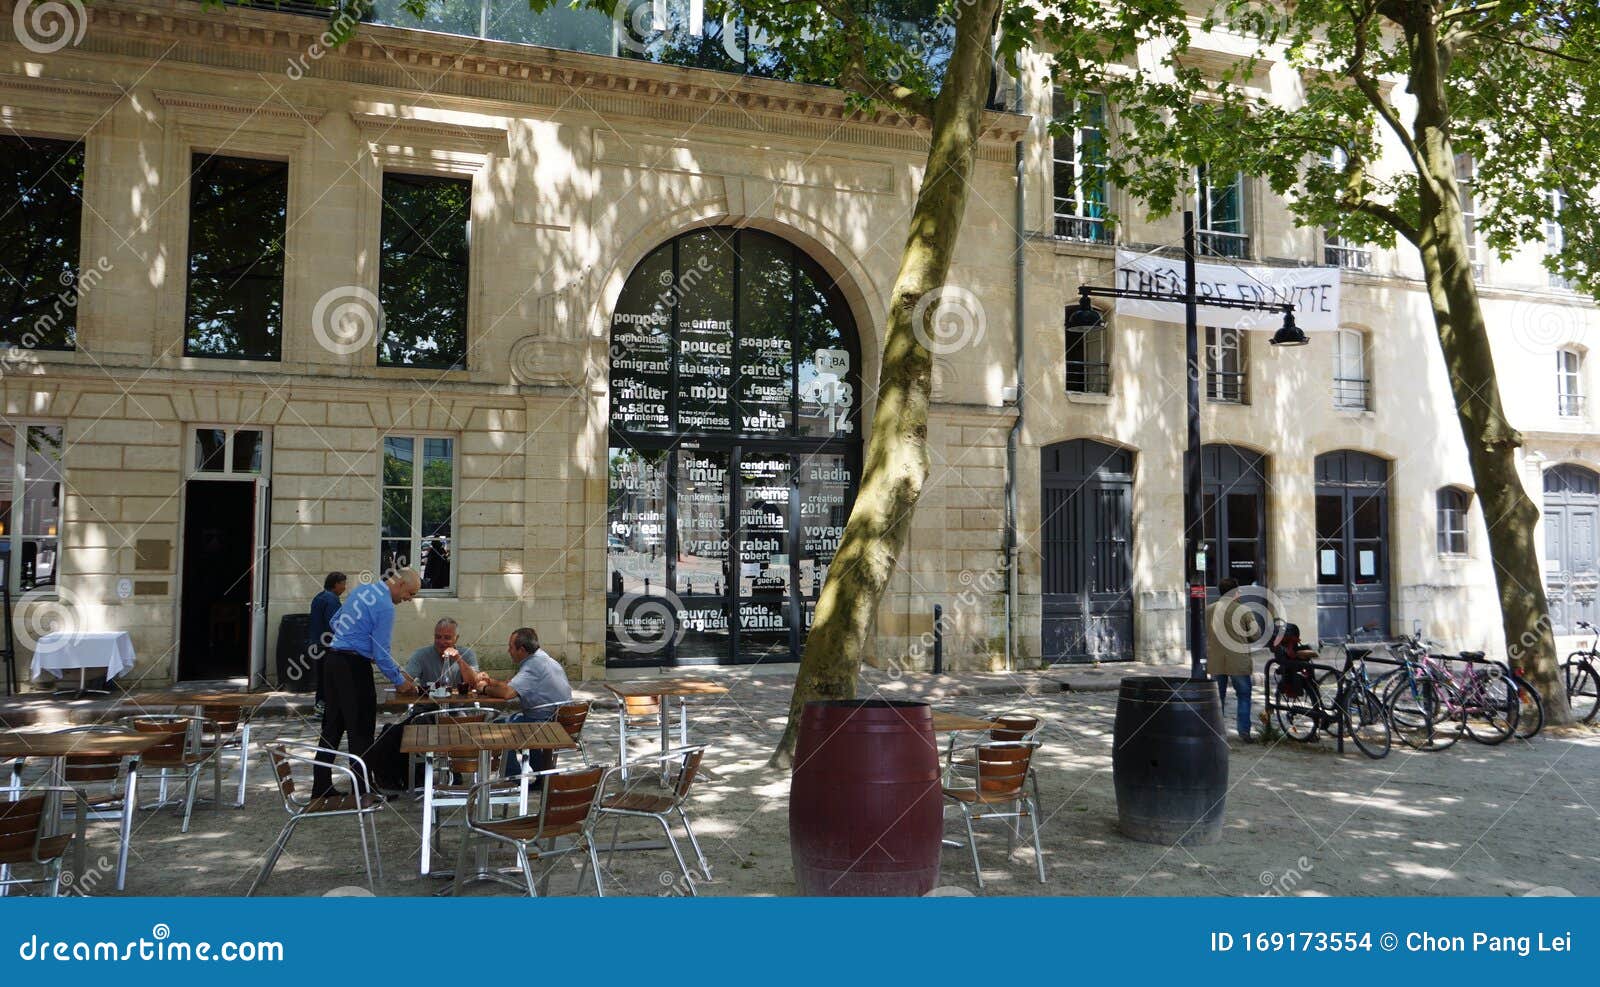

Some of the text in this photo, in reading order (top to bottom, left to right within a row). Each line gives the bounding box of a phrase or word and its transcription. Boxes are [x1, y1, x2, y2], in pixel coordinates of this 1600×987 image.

[1119, 267, 1227, 299] THÉÂRE
[692, 318, 732, 330] enfant
[681, 341, 732, 354] poucet
[741, 336, 791, 349] soapéra
[679, 362, 731, 376] claustria
[740, 364, 780, 376] cartel
[612, 377, 635, 388] café
[691, 386, 727, 399] mou
[751, 383, 790, 396] fausse
[628, 403, 665, 413] sacre
[612, 412, 669, 422] du printemps
[678, 415, 730, 426] happiness
[742, 413, 786, 429] verità
[824, 407, 854, 433] 14
[686, 458, 709, 470] pied
[740, 461, 791, 470] cendrillon
[690, 469, 728, 481] mur
[810, 468, 851, 480] aladin
[800, 503, 830, 514] 2014
[677, 518, 725, 530] parents
[740, 513, 784, 527] puntila
[611, 521, 665, 537] feydeau
[684, 540, 730, 552] cyrano
[740, 538, 779, 551] rabah
[740, 551, 770, 560] robert
[740, 605, 768, 615] oncle
[634, 617, 665, 625] incident
[683, 616, 729, 631] orgueil
[740, 612, 783, 628] vania
